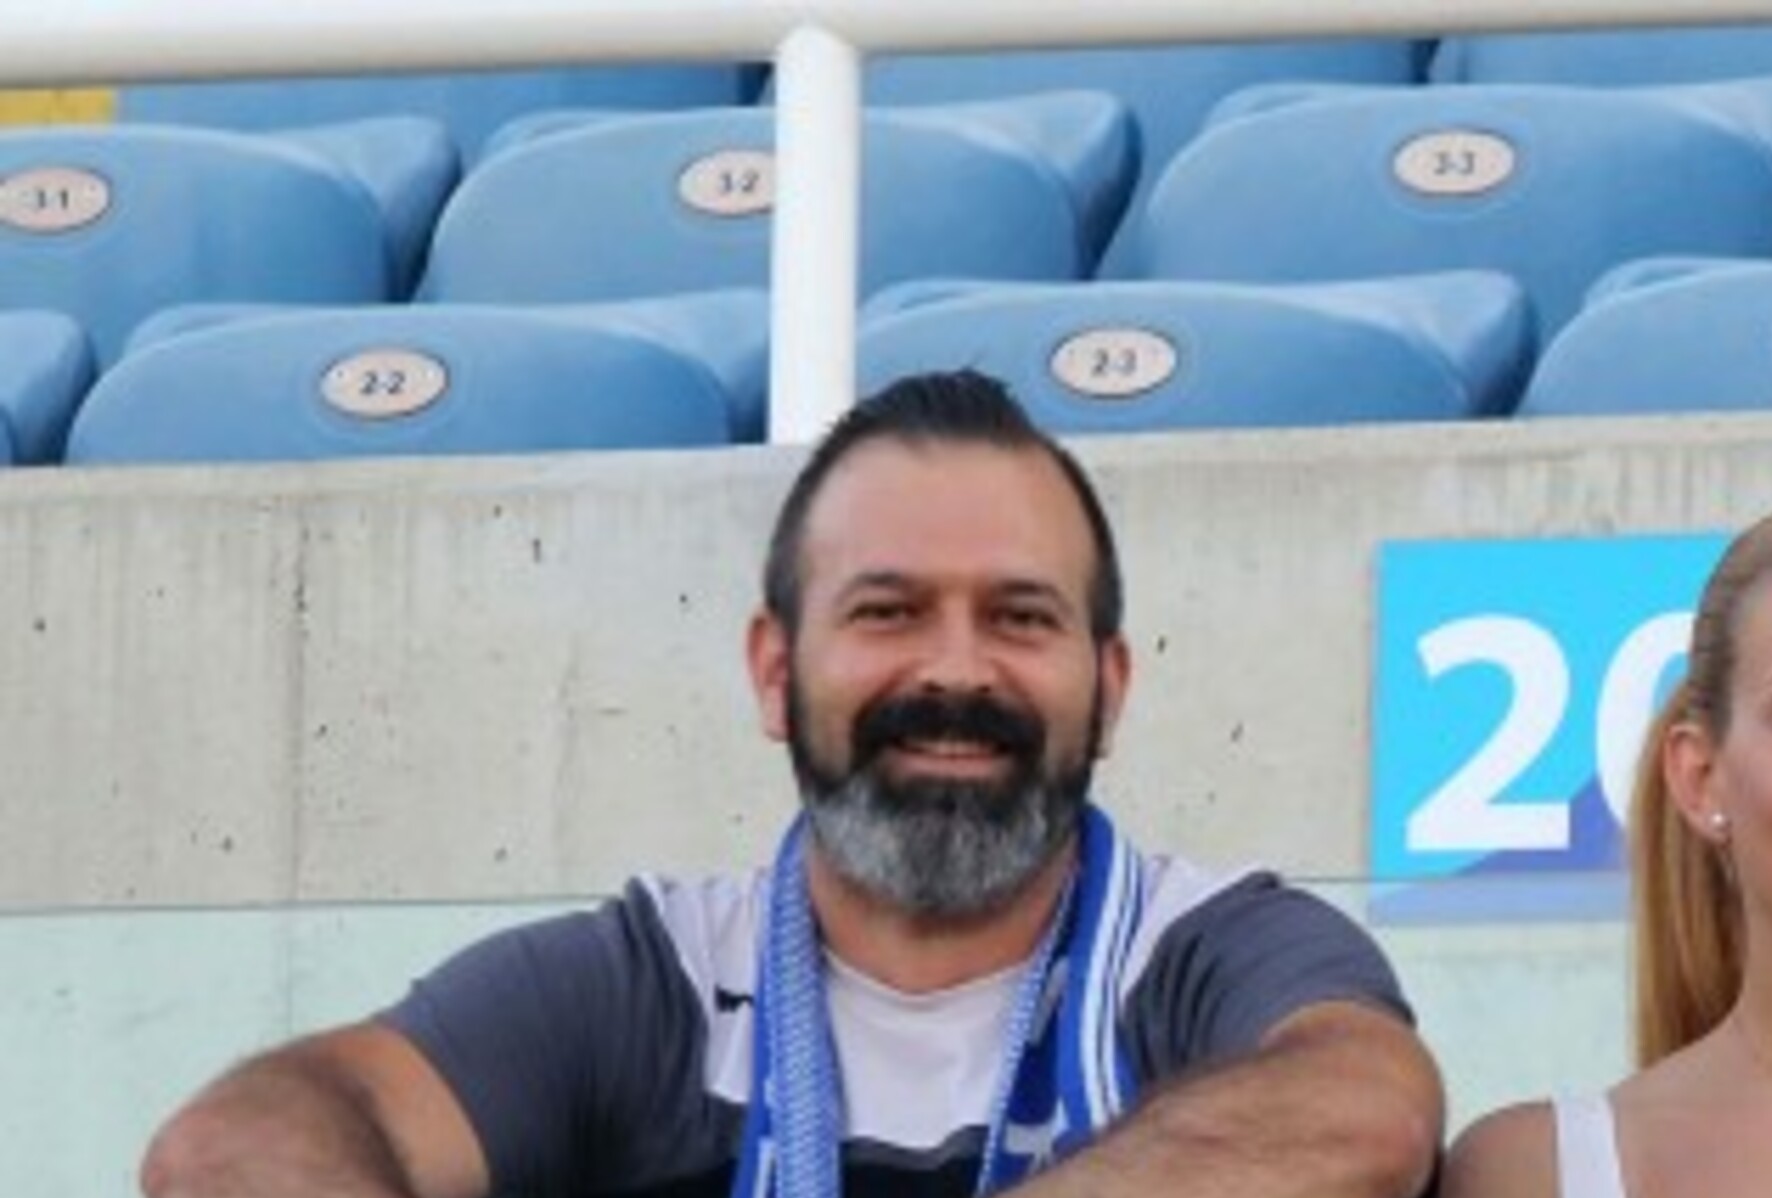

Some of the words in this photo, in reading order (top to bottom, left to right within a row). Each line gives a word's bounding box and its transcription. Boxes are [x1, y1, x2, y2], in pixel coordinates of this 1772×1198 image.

[1433, 149, 1476, 176] 3-3
[1090, 347, 1138, 376] 2-3
[359, 369, 407, 396] 2-2
